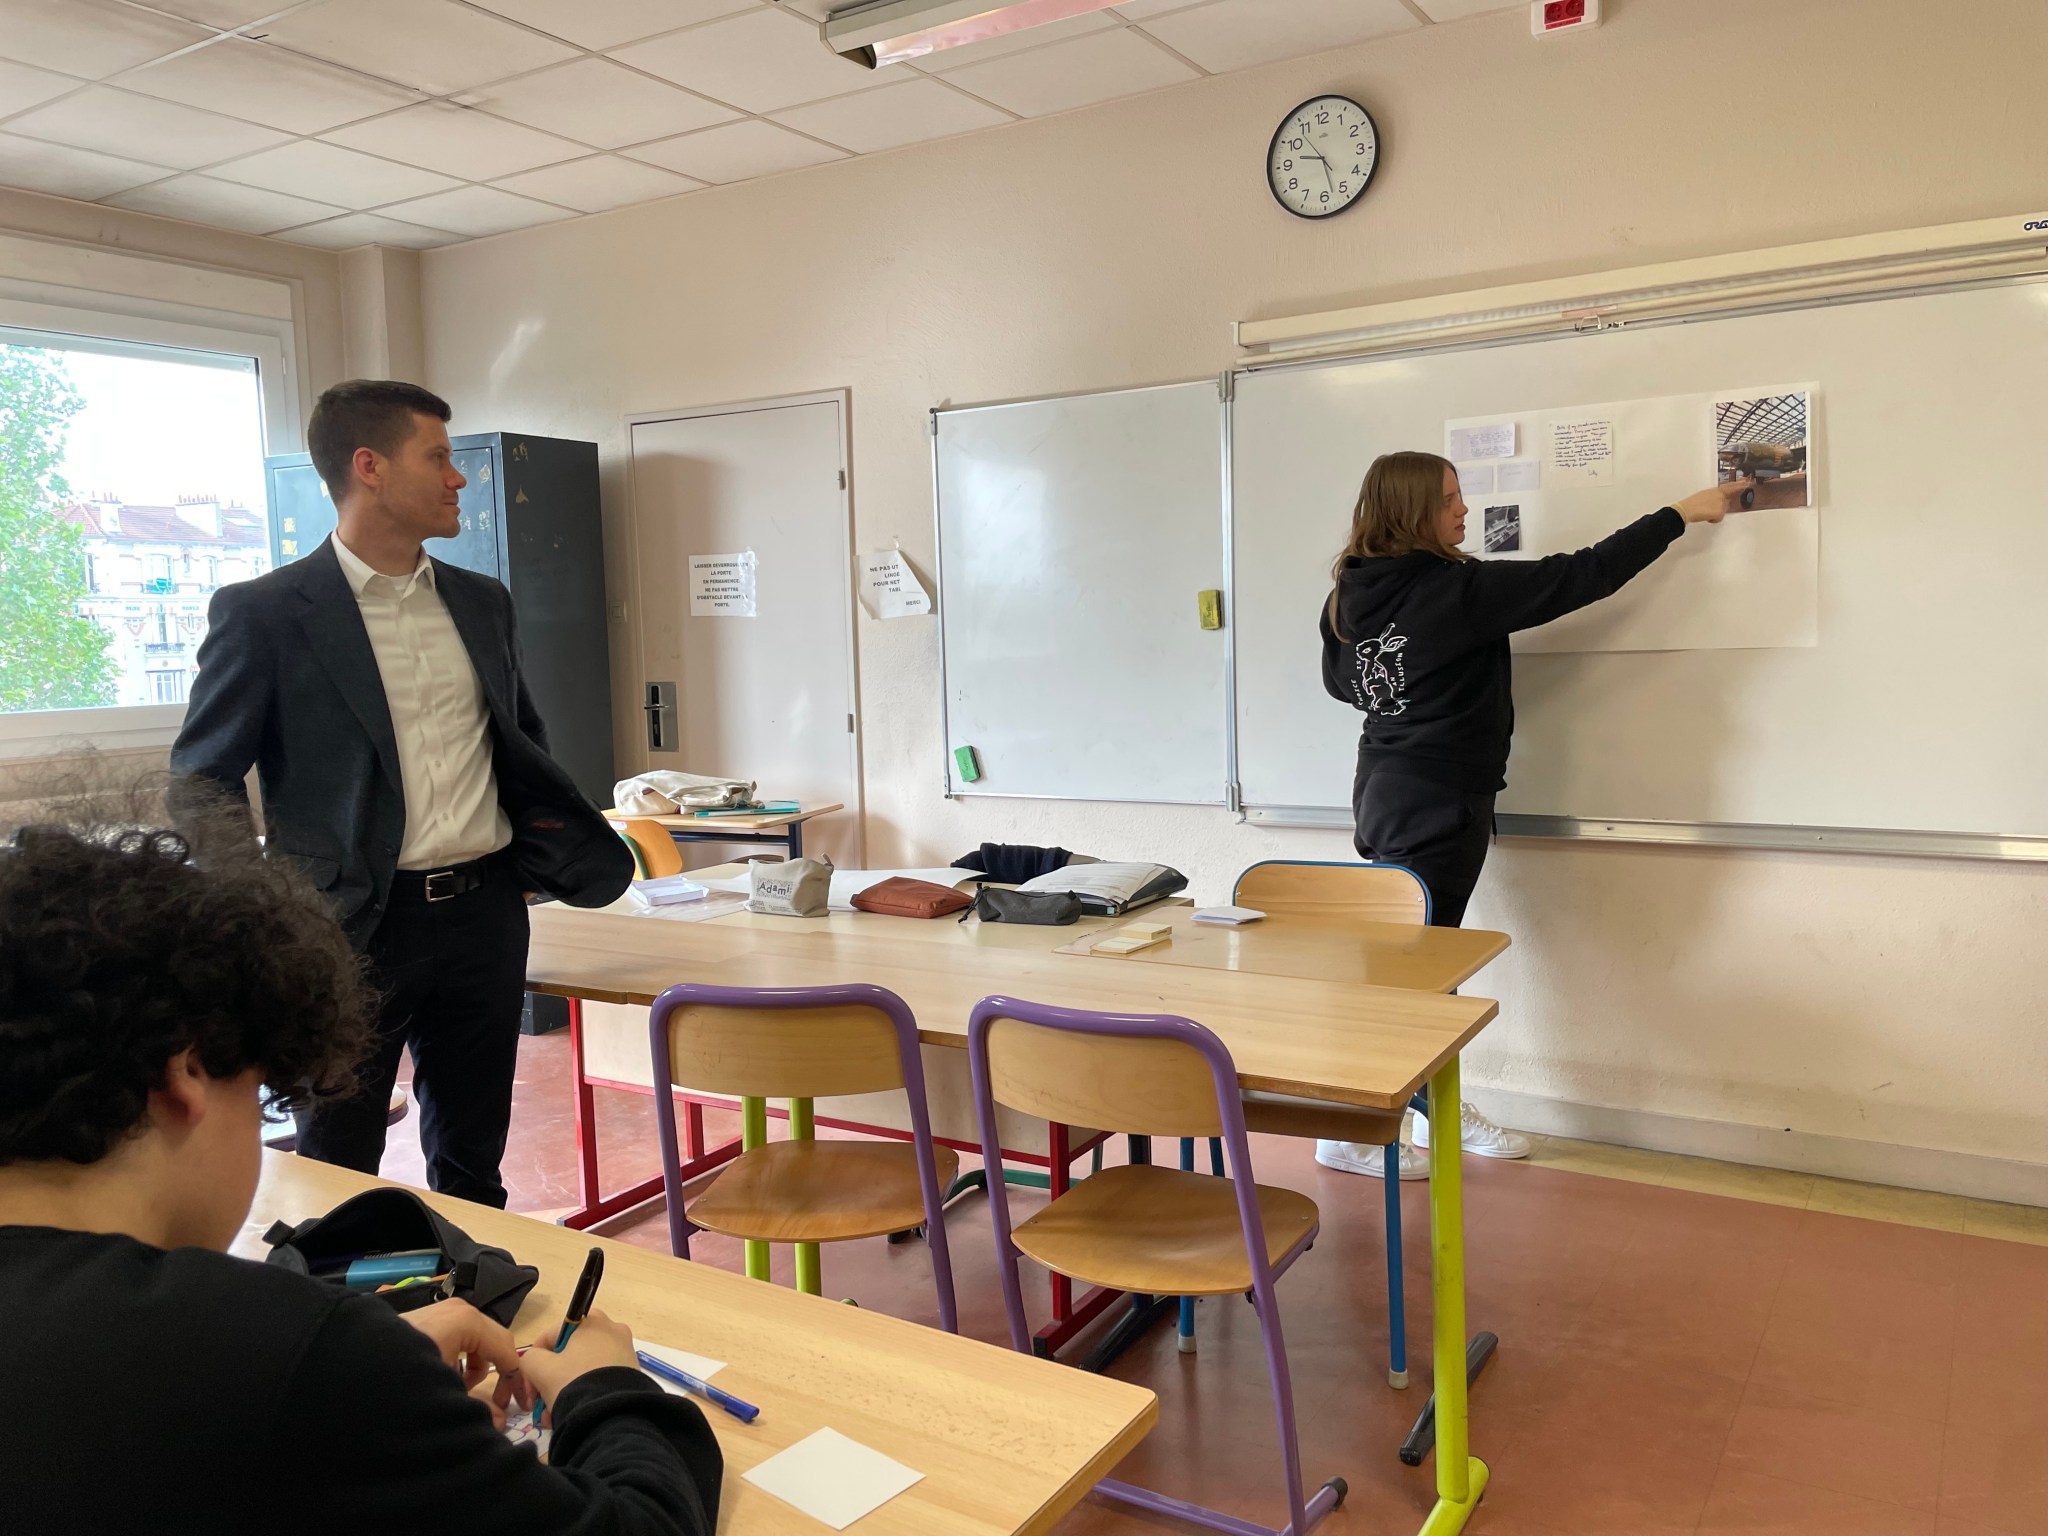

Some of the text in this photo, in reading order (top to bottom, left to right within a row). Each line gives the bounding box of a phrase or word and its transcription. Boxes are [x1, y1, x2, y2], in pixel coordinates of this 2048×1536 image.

[1314, 111, 1330, 125] 12
[1337, 113, 1343, 126] 1
[1299, 121, 1310, 135] 11
[1349, 124, 1359, 138] 2
[1287, 137, 1303, 152] 10
[1355, 142, 1365, 155] 3
[1283, 159, 1293, 171] 9
[1351, 163, 1361, 176] 4
[1288, 177, 1298, 190] 8
[1338, 180, 1348, 194] 5
[1301, 189, 1310, 201] 7
[1319, 190, 1330, 203] 6
[1356, 660, 1362, 670] IS
[1394, 652, 1405, 692] ILLUSION
[1390, 676, 1398, 687] AN
[1350, 679, 1364, 706] CHOICE
[759, 881, 790, 896] Adami
